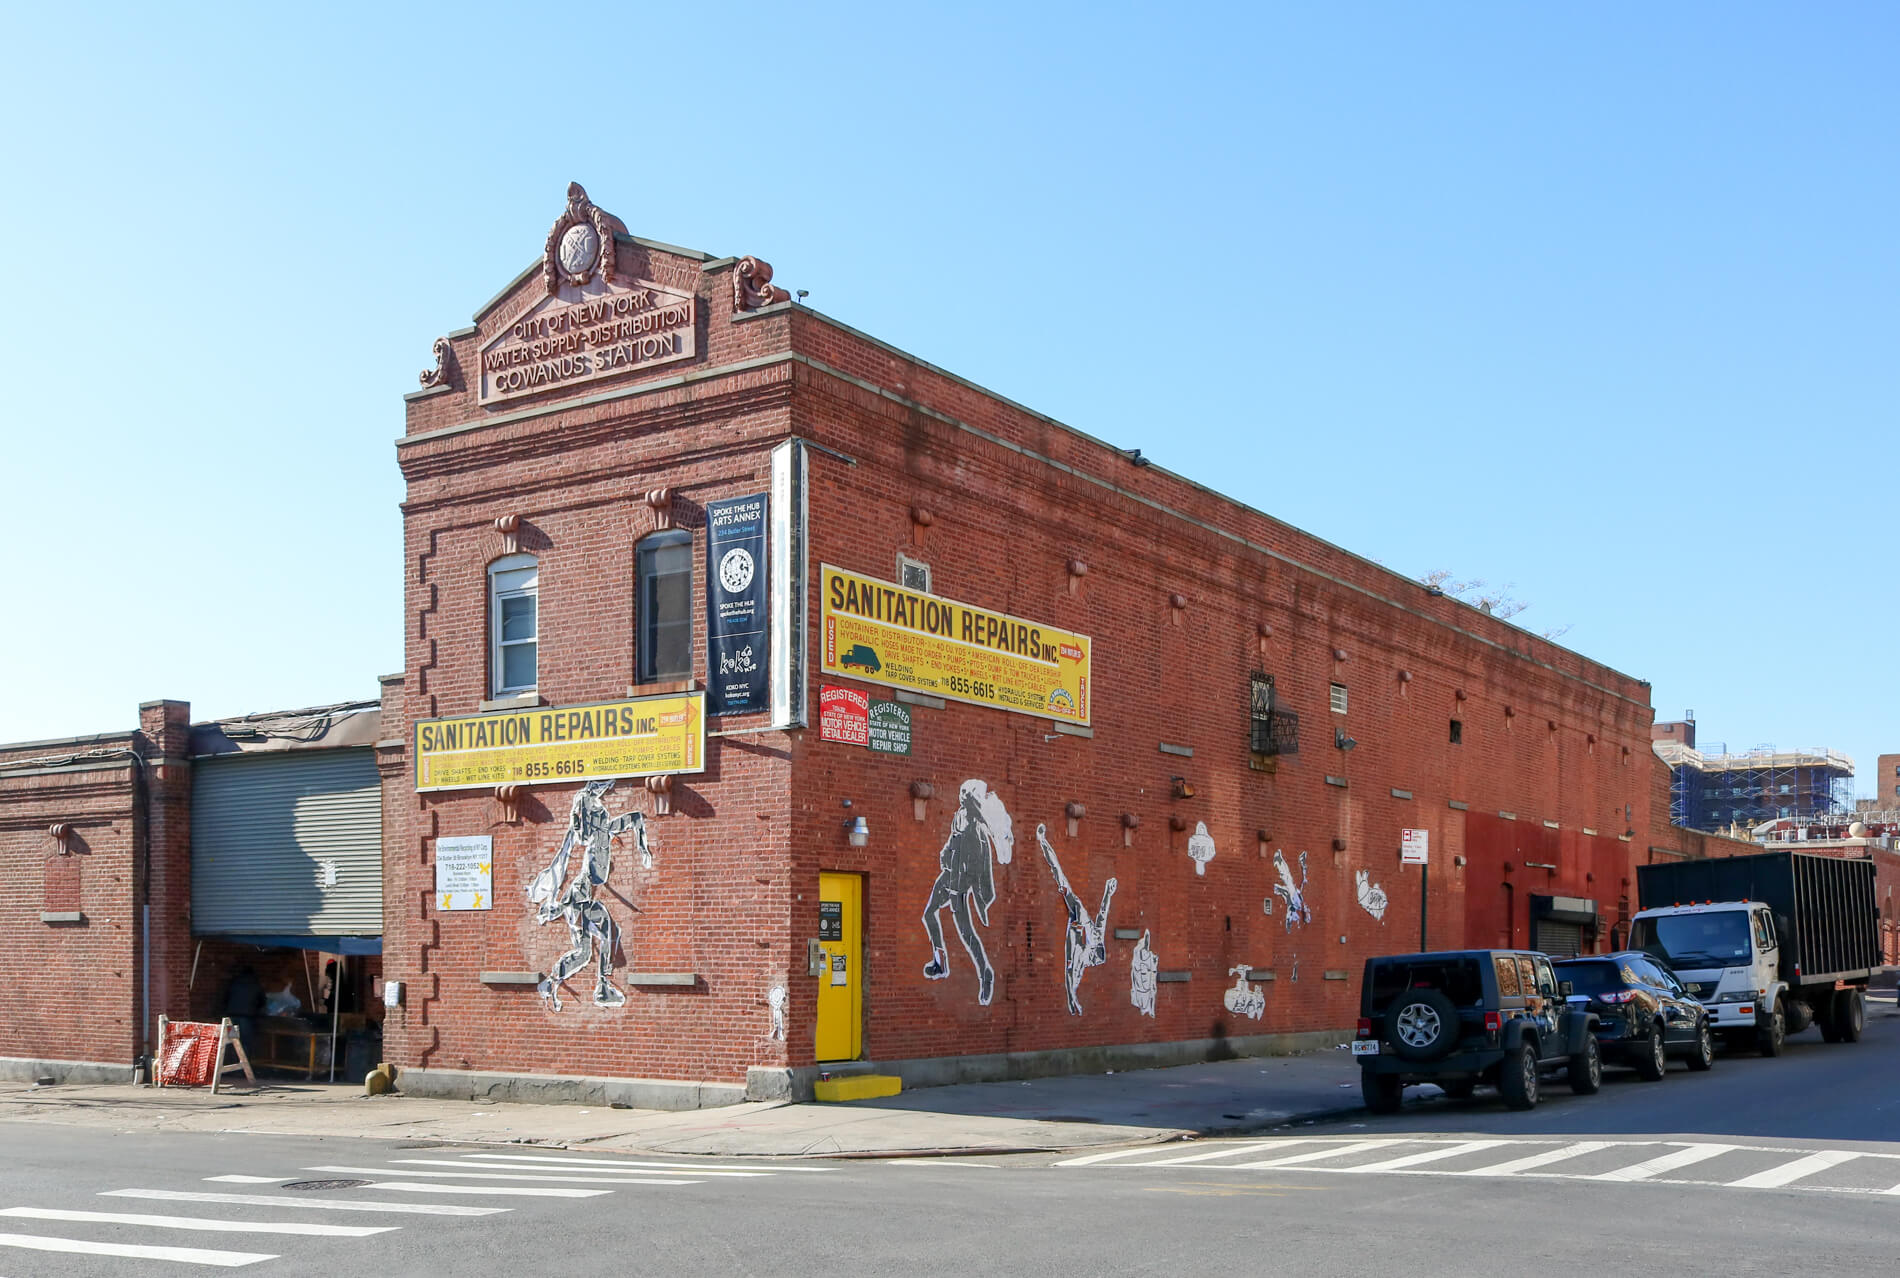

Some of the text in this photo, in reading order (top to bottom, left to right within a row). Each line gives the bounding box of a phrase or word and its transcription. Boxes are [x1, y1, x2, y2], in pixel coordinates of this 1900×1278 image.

[513, 290, 651, 339] CITY OF NEW YORK
[484, 344, 530, 371] WATER
[495, 332, 676, 393] GOWANUS STATION
[713, 502, 760, 518] SPOKE THE HUB
[713, 510, 761, 527] ARTS ANNEX
[720, 602, 734, 610] SPOKE
[831, 575, 1060, 665] SANITATION REPAIRS INC.
[840, 619, 879, 636] CONTAINER
[971, 650, 1000, 666] AMERICAN
[840, 629, 880, 647] HYDRAULIC
[881, 639, 899, 651] HOSES
[900, 643, 915, 654] MADE
[916, 646, 924, 656] TO
[924, 648, 943, 660] ORDER
[947, 653, 967, 666] PUMPS
[885, 649, 900, 662] DRIVE
[902, 653, 924, 666] SHAFTS
[943, 662, 961, 674] YOKES
[885, 662, 914, 675] WELDING
[726, 682, 750, 691] KOKO NYC
[885, 670, 938, 688] TARP COVER SYSTEMS
[820, 689, 868, 710] REGISTERED
[998, 687, 1026, 699] HYDRAULIC
[869, 703, 910, 725] REGISTERED
[422, 706, 658, 752] SANITATION REPAIRS INC.
[821, 718, 867, 733] MOTOR VEHICLE
[822, 728, 866, 743] RETAIL DEALER
[869, 728, 911, 743] MOTOR VEHICLE
[872, 740, 908, 753] REPAIR SHOP
[592, 756, 619, 765] WELDING
[657, 752, 681, 760] SYSTEMS
[445, 862, 480, 871] 718-222-1052
